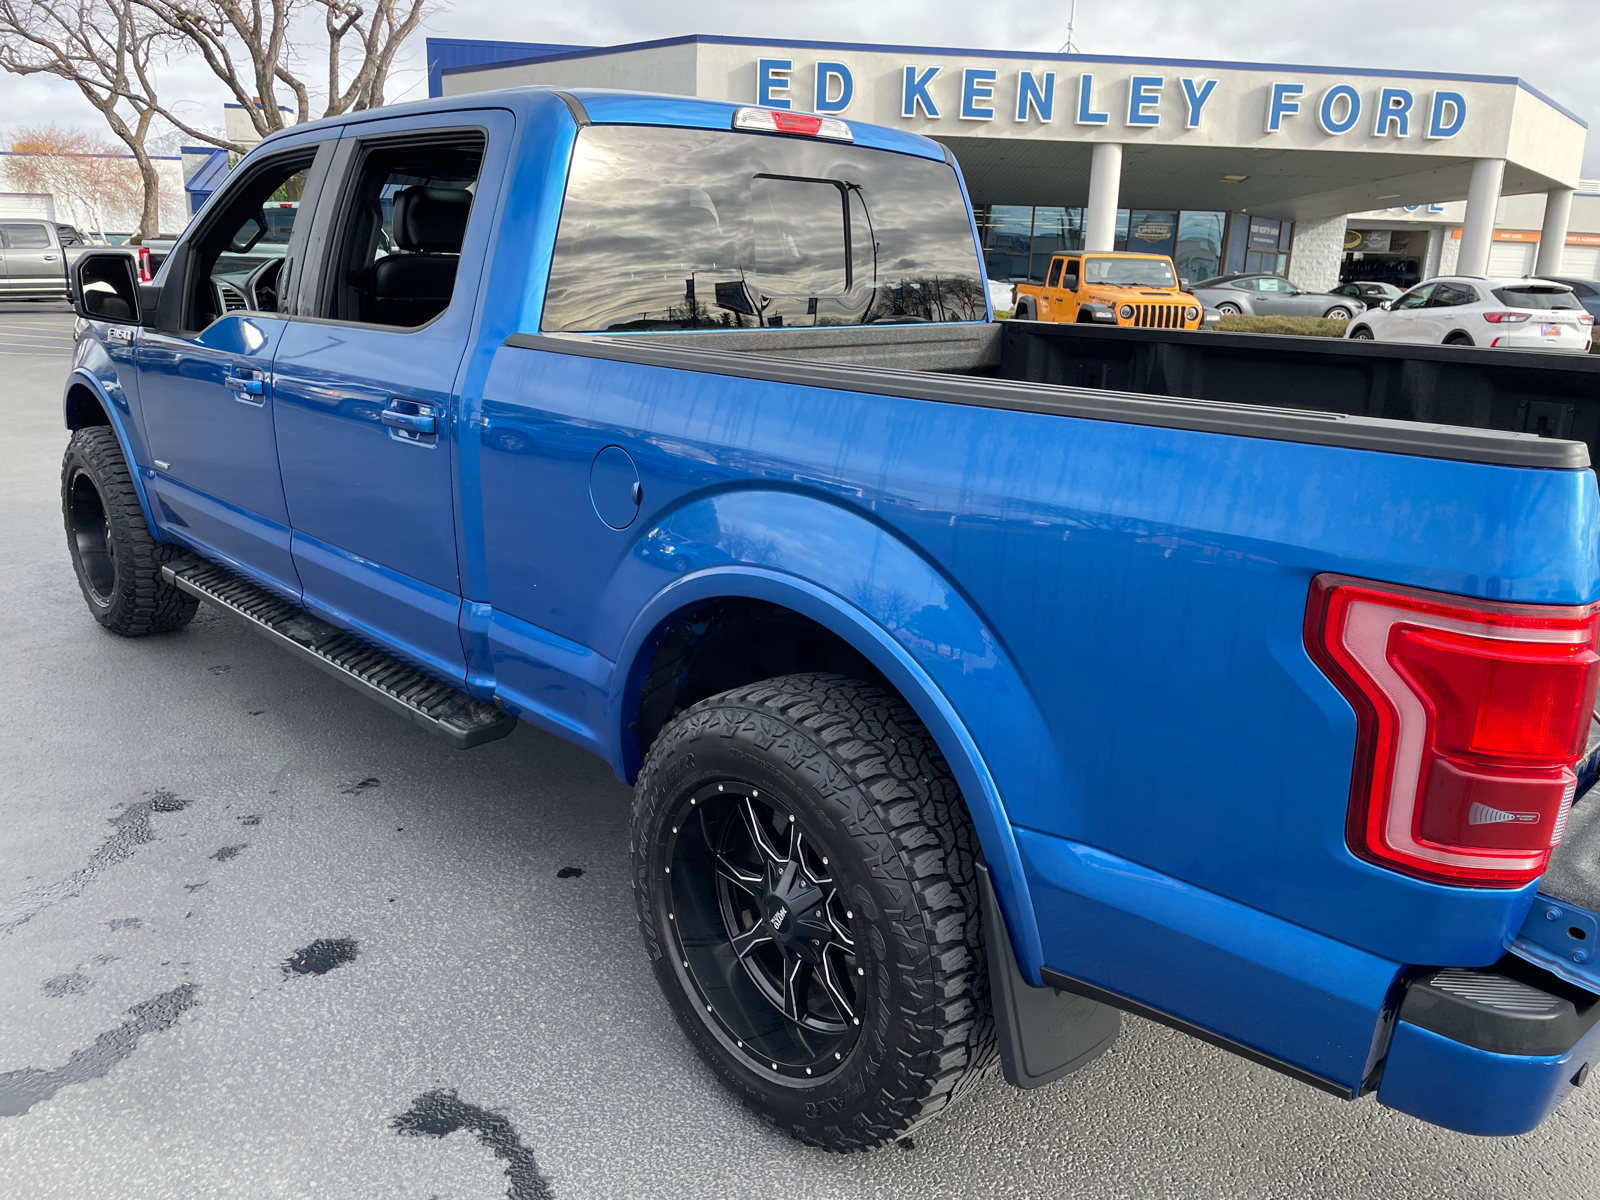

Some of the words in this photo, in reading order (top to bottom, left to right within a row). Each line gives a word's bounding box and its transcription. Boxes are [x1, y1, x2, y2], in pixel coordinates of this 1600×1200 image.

[757, 57, 855, 114] ED
[900, 64, 1221, 129] KENLEY
[1264, 82, 1468, 140] FORD
